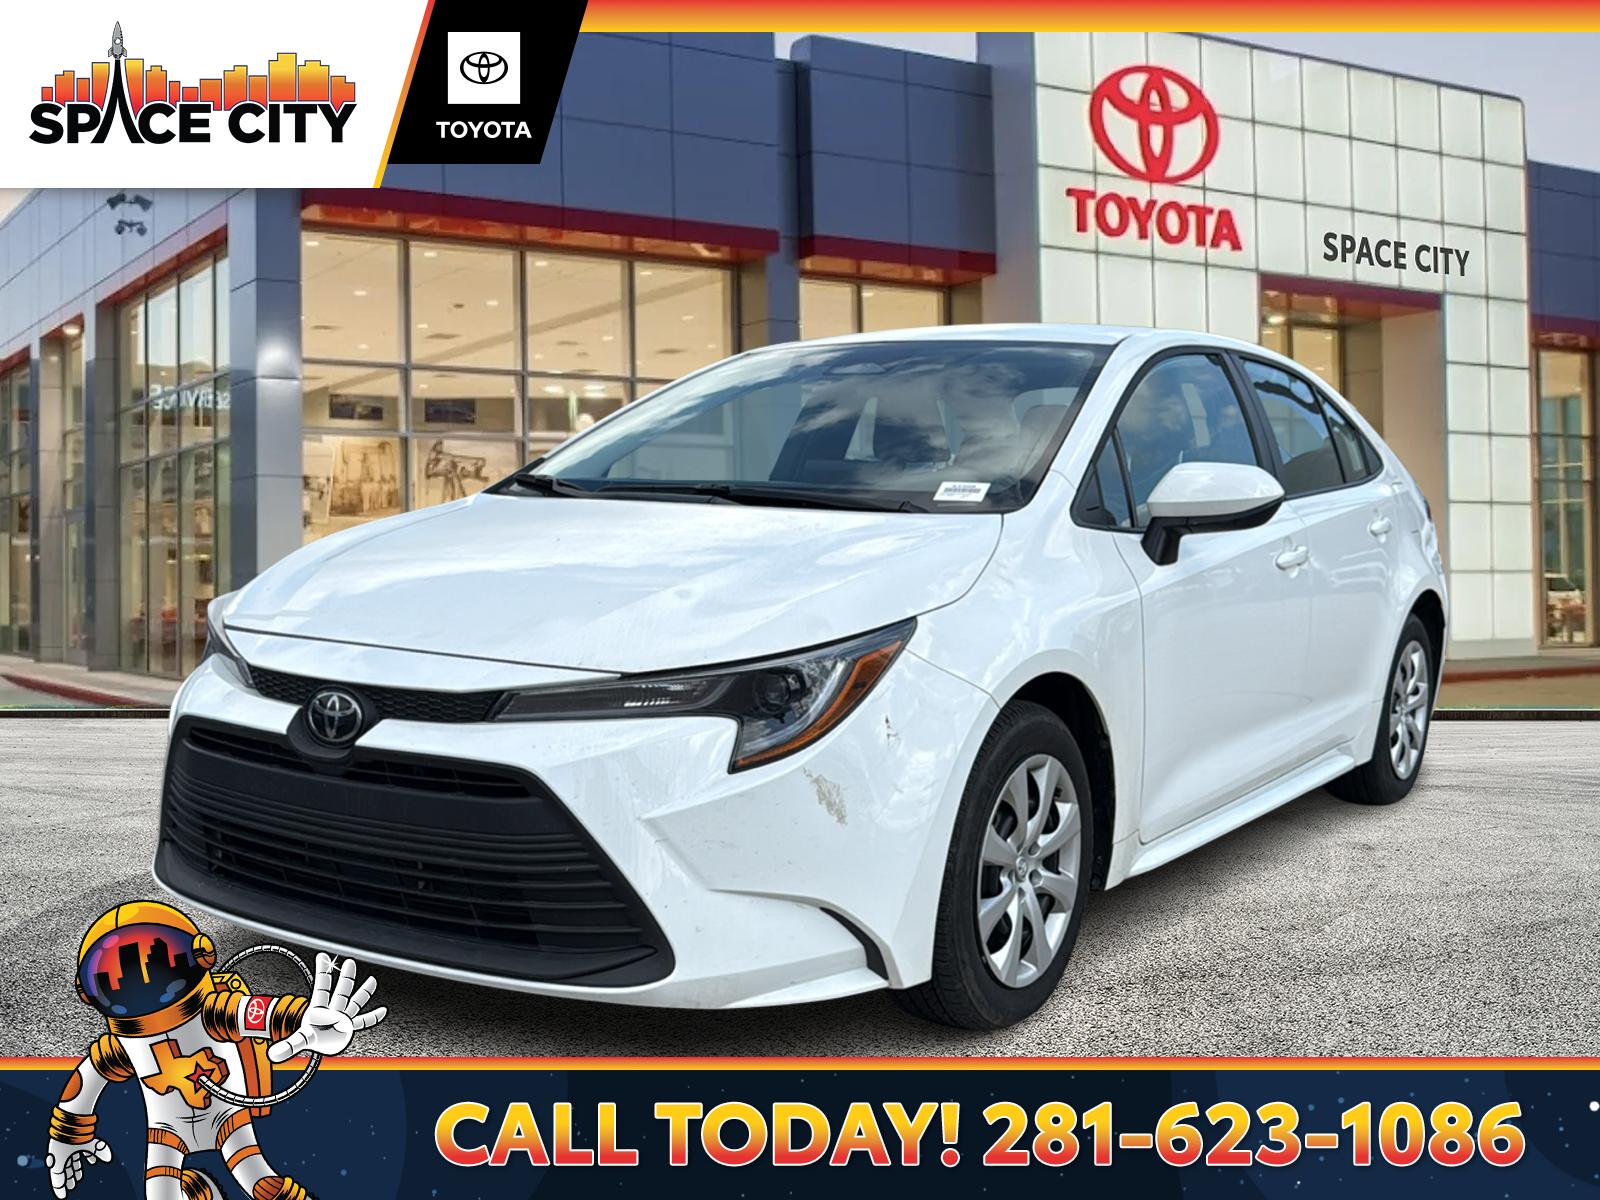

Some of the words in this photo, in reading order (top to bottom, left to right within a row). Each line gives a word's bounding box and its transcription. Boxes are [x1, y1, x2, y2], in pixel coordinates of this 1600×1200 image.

[1066, 188, 1242, 251] TOYOTA
[1323, 232, 1407, 270] SPACE
[1415, 245, 1470, 277] CITY
